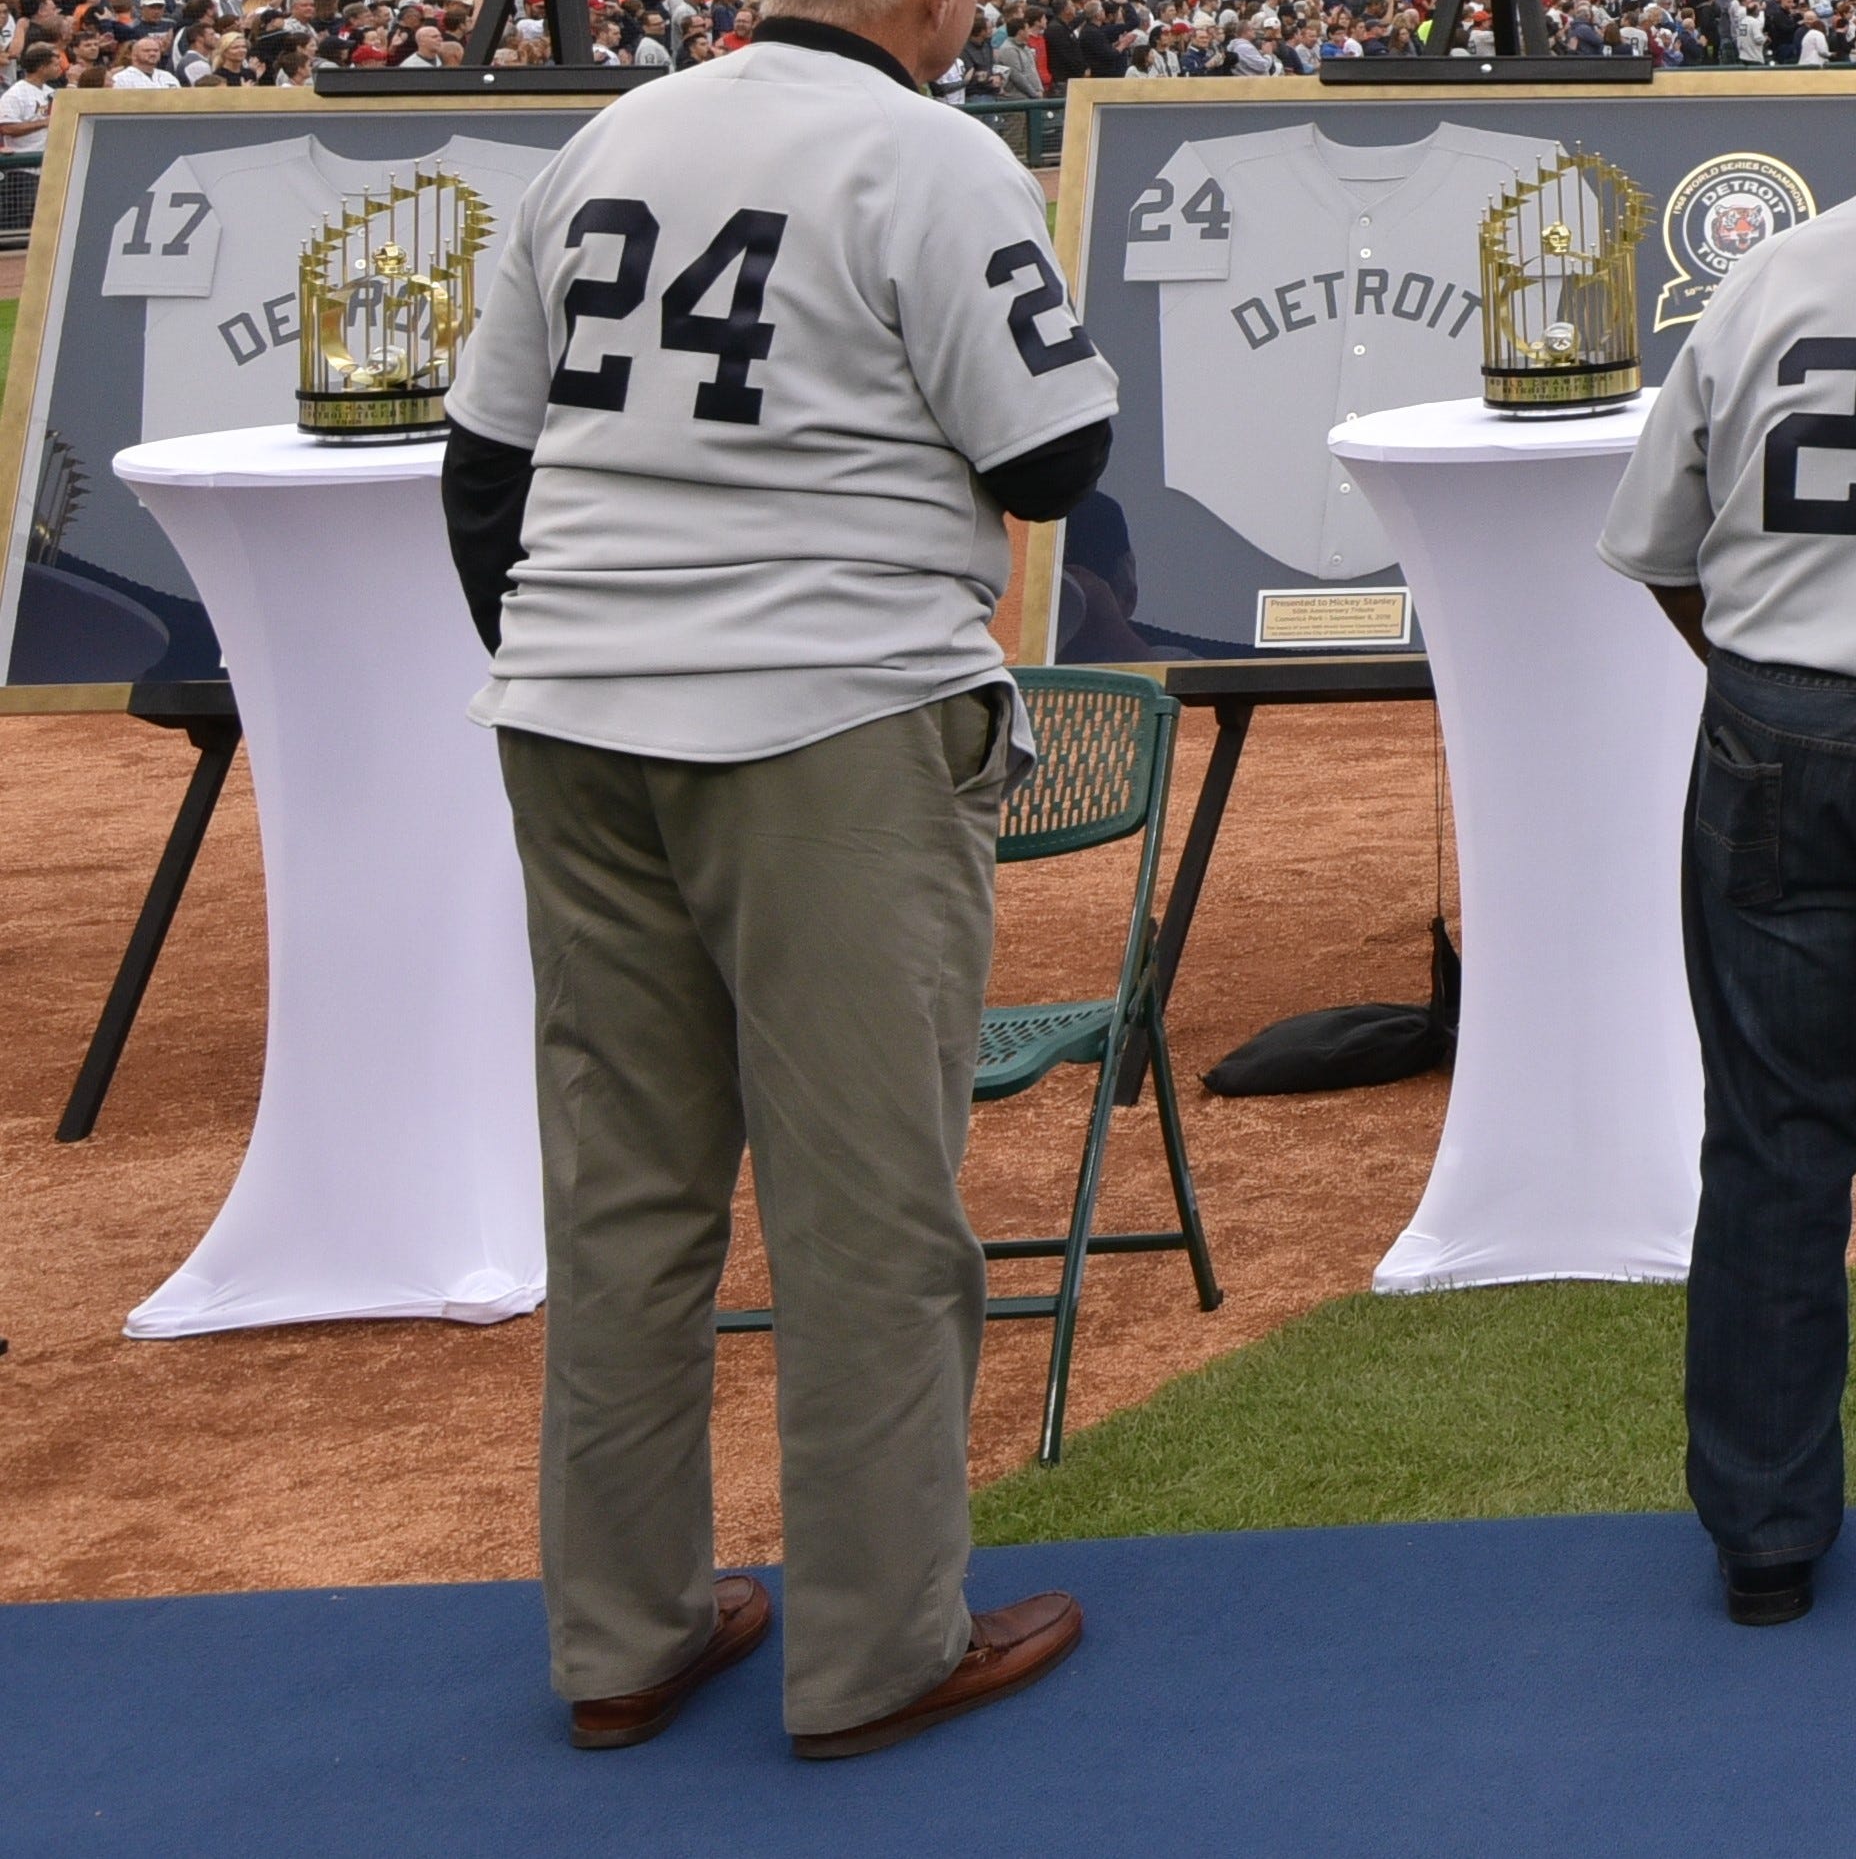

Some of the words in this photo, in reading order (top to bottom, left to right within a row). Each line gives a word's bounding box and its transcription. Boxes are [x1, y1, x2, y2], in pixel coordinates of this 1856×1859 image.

[1129, 177, 1231, 242] 24
[1685, 167, 1719, 195] WORLD
[1720, 161, 1760, 173] SERIES
[1761, 165, 1806, 213] CHAMPIONS
[1702, 180, 1787, 213] DETROIT
[123, 192, 212, 255] 17
[547, 198, 788, 425] 24
[1231, 268, 1483, 350] DETROIT
[1271, 598, 1315, 607] Presented
[1329, 598, 1361, 608] Mickey
[1364, 597, 1397, 607] Stanley
